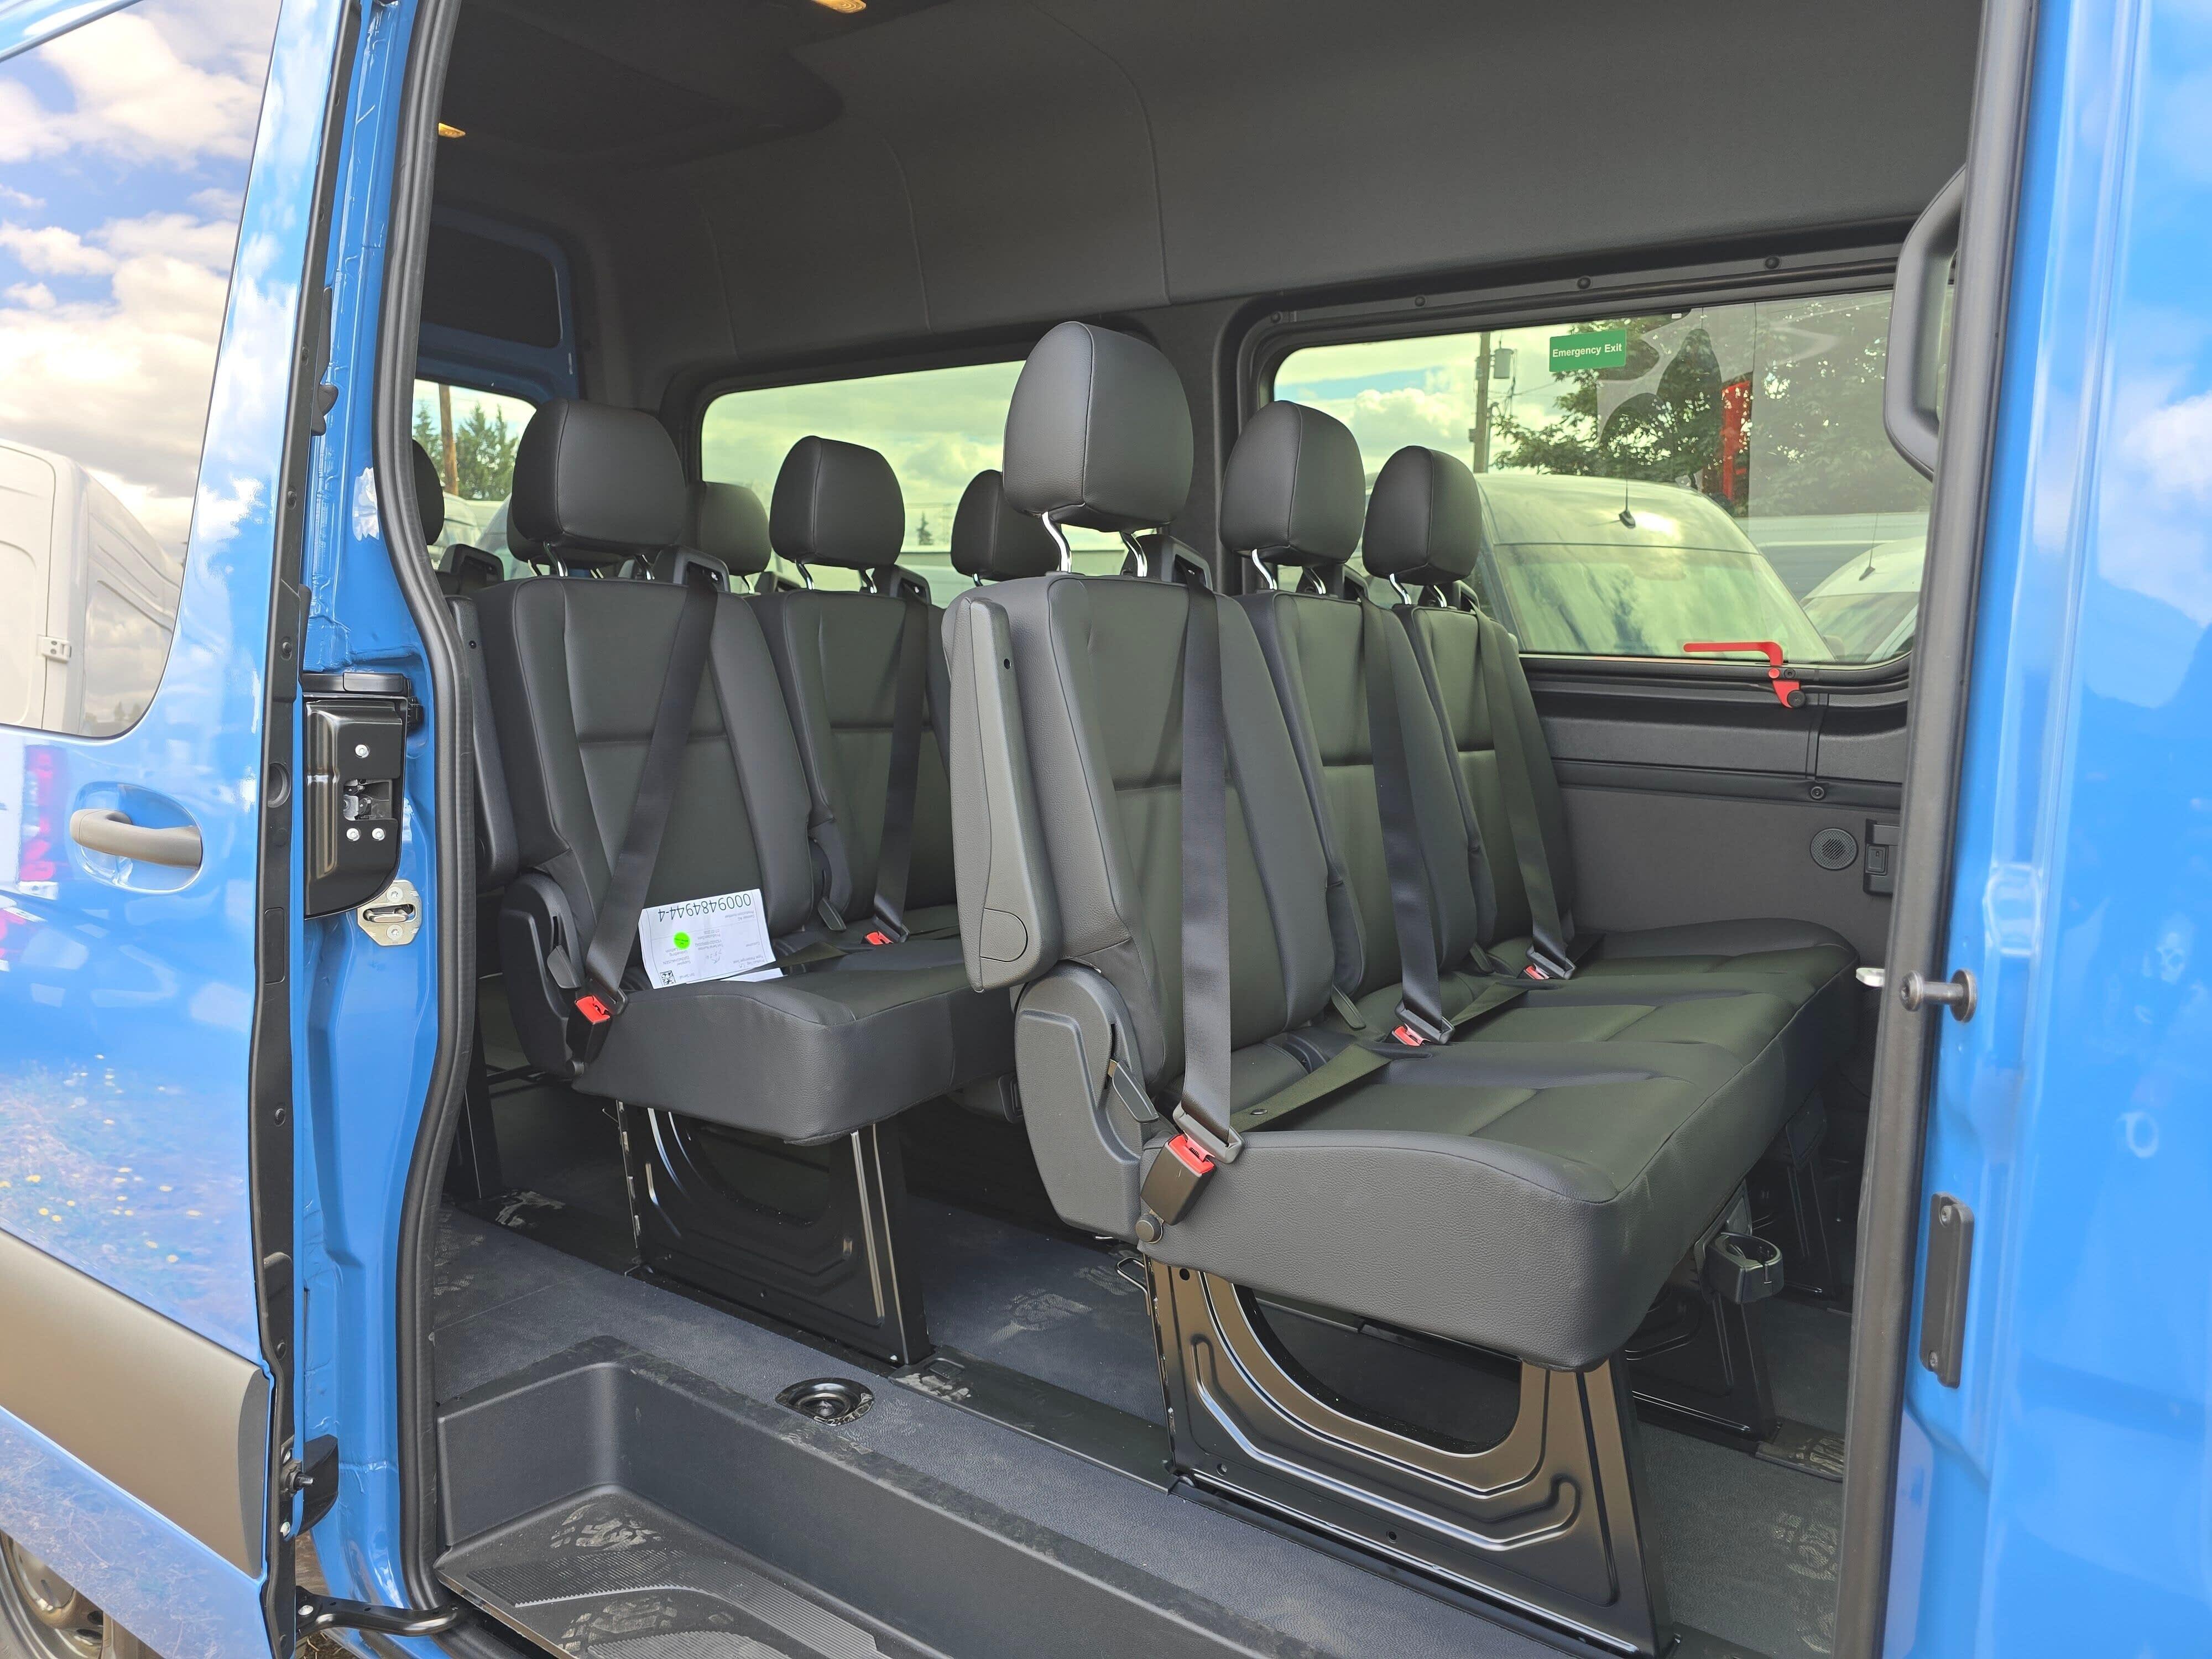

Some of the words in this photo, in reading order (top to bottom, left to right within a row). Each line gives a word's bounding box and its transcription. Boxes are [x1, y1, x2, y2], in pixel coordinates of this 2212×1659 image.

[1552, 347, 1601, 357] Emergency
[1604, 343, 1622, 353] Exit
[658, 894, 751, 922] 0009484944-4
